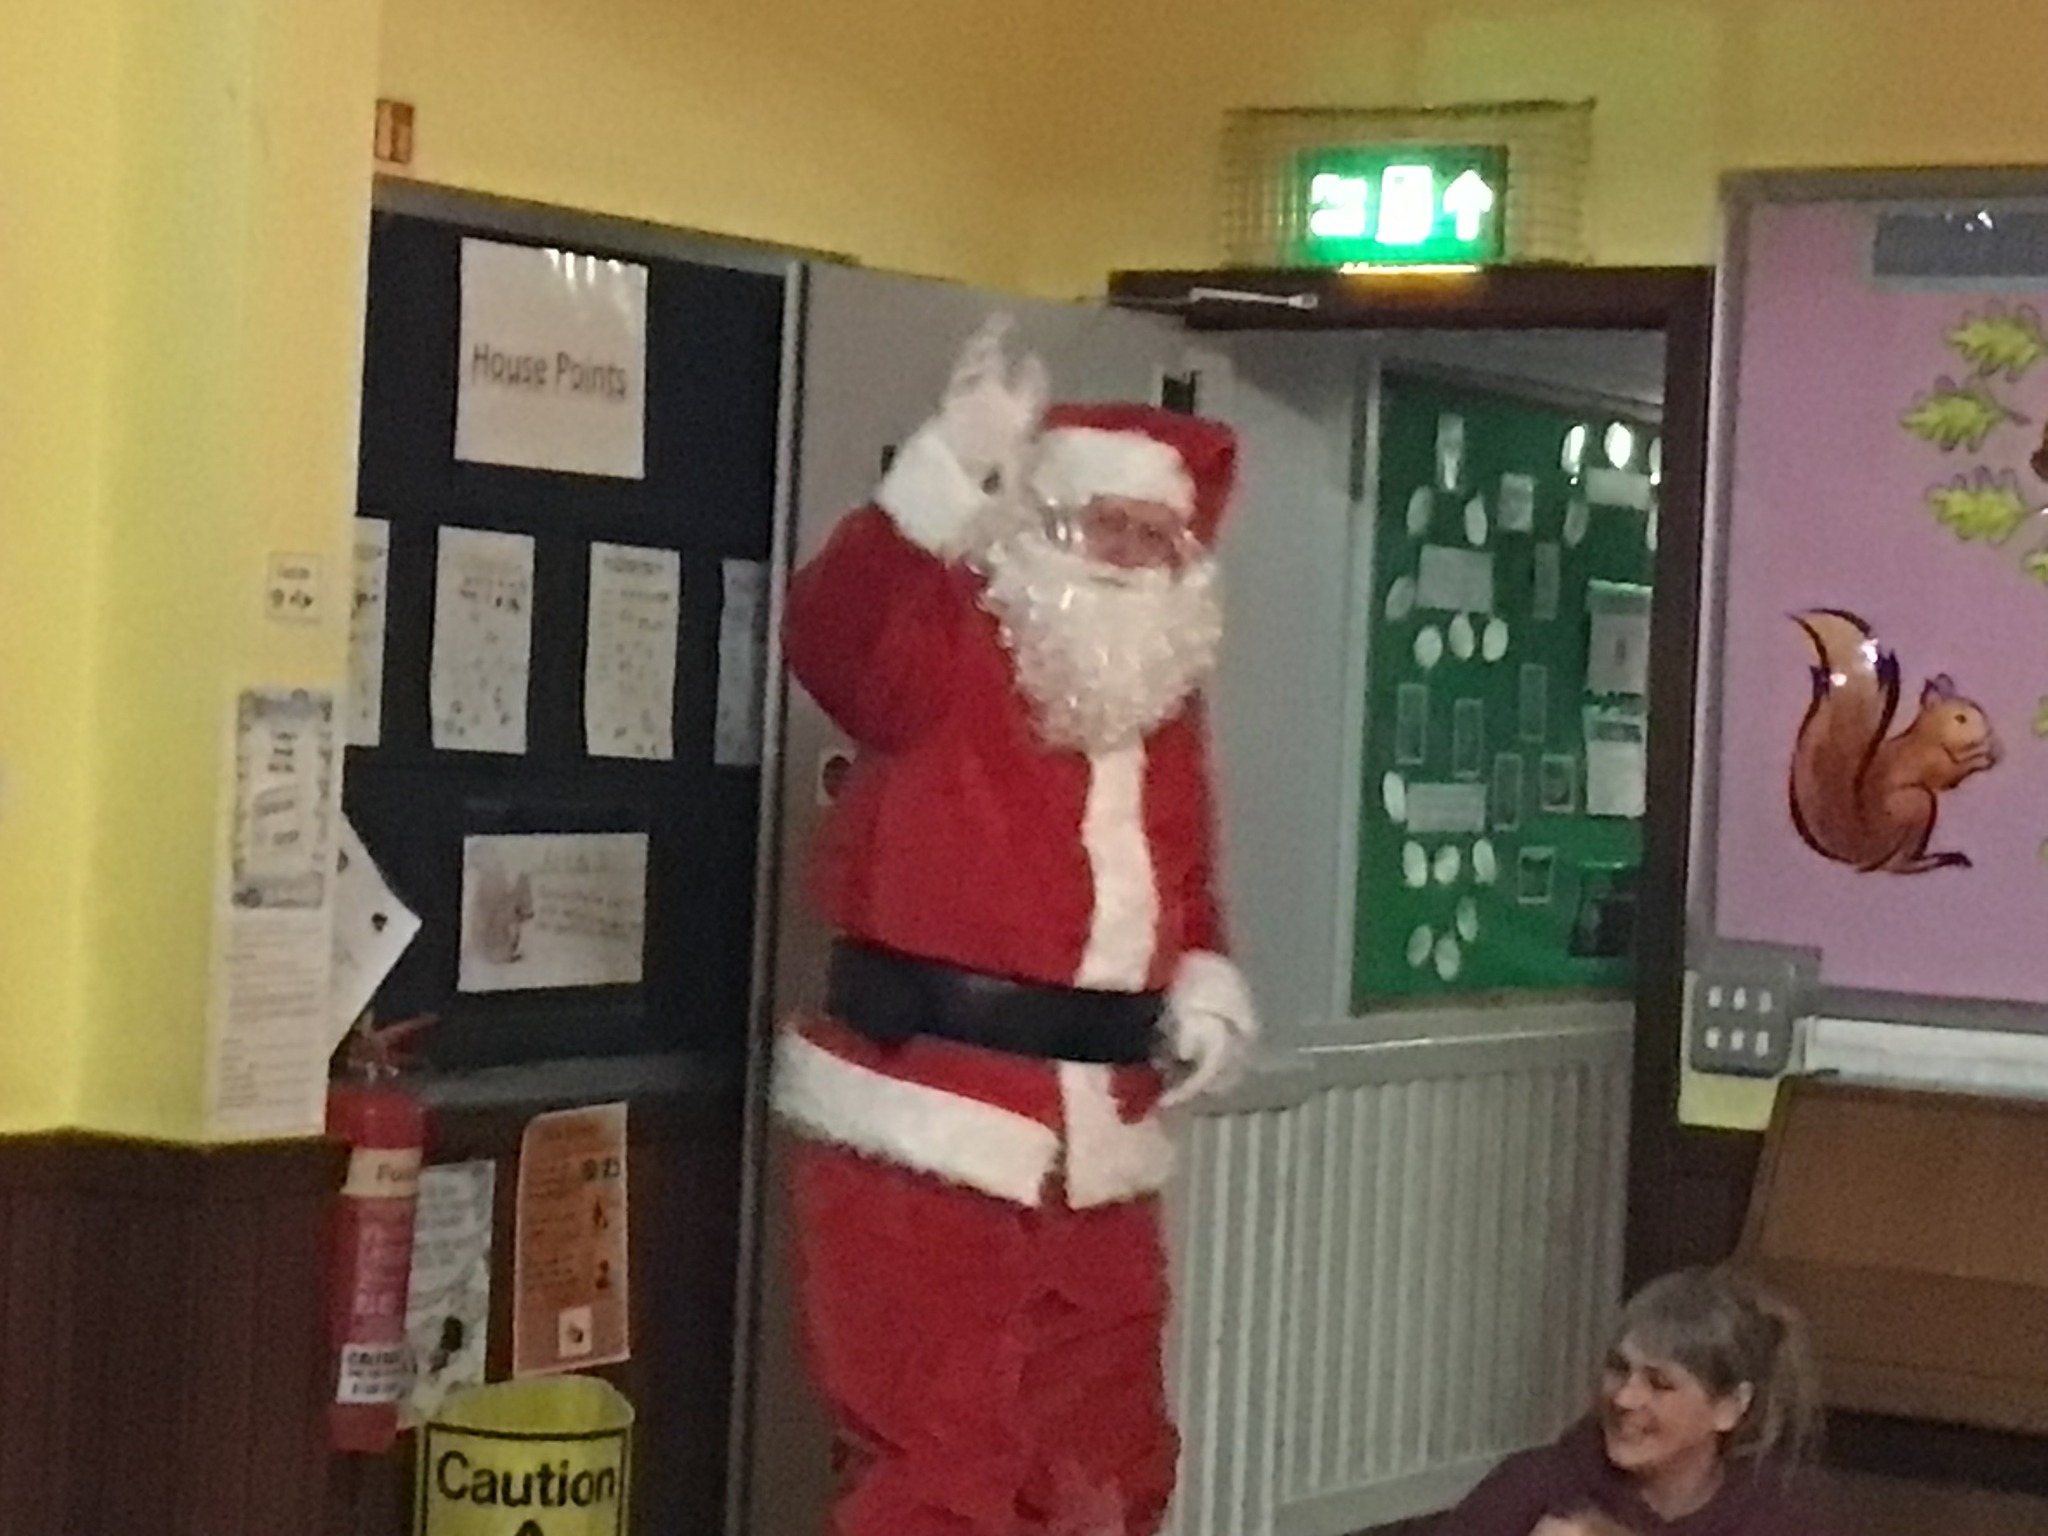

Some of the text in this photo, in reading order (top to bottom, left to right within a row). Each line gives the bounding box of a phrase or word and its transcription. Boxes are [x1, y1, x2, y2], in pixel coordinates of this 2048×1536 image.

[472, 344, 627, 398] House Points
[437, 1450, 615, 1507] Caution
